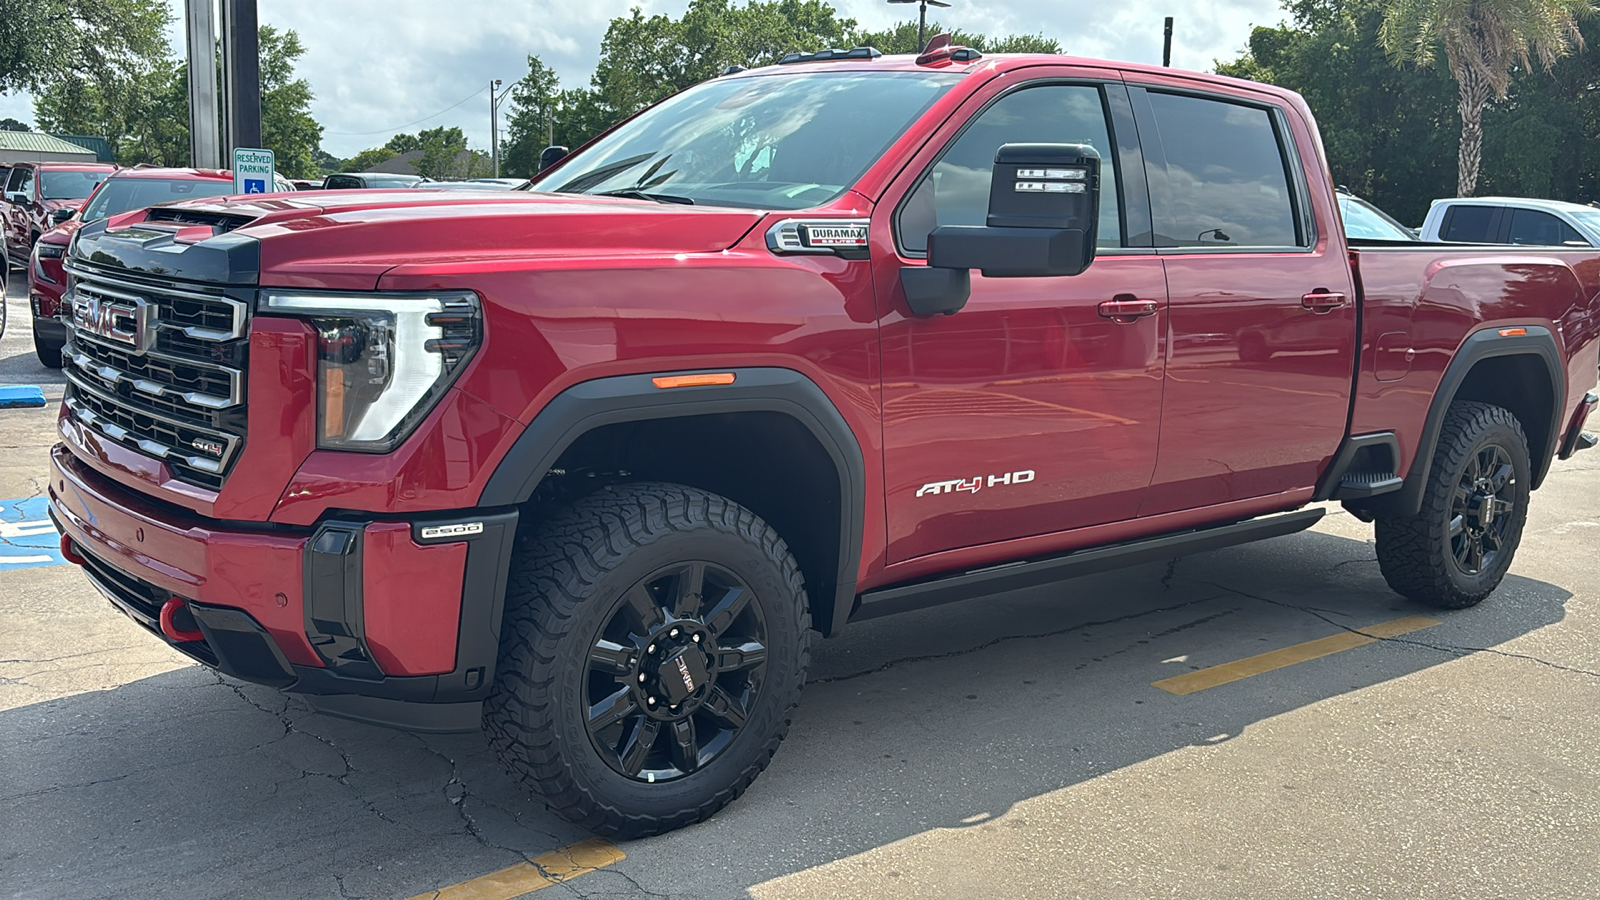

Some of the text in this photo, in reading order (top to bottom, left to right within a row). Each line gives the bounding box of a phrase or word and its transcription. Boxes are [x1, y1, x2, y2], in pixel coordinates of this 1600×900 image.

[237, 154, 271, 163] RESERVED
[239, 164, 269, 173] PARKING
[812, 229, 863, 238] DURAMAX
[73, 293, 137, 345] GMC
[915, 469, 1035, 497] AT4 HD
[422, 523, 483, 538] 2500
[674, 655, 695, 693] GMC
